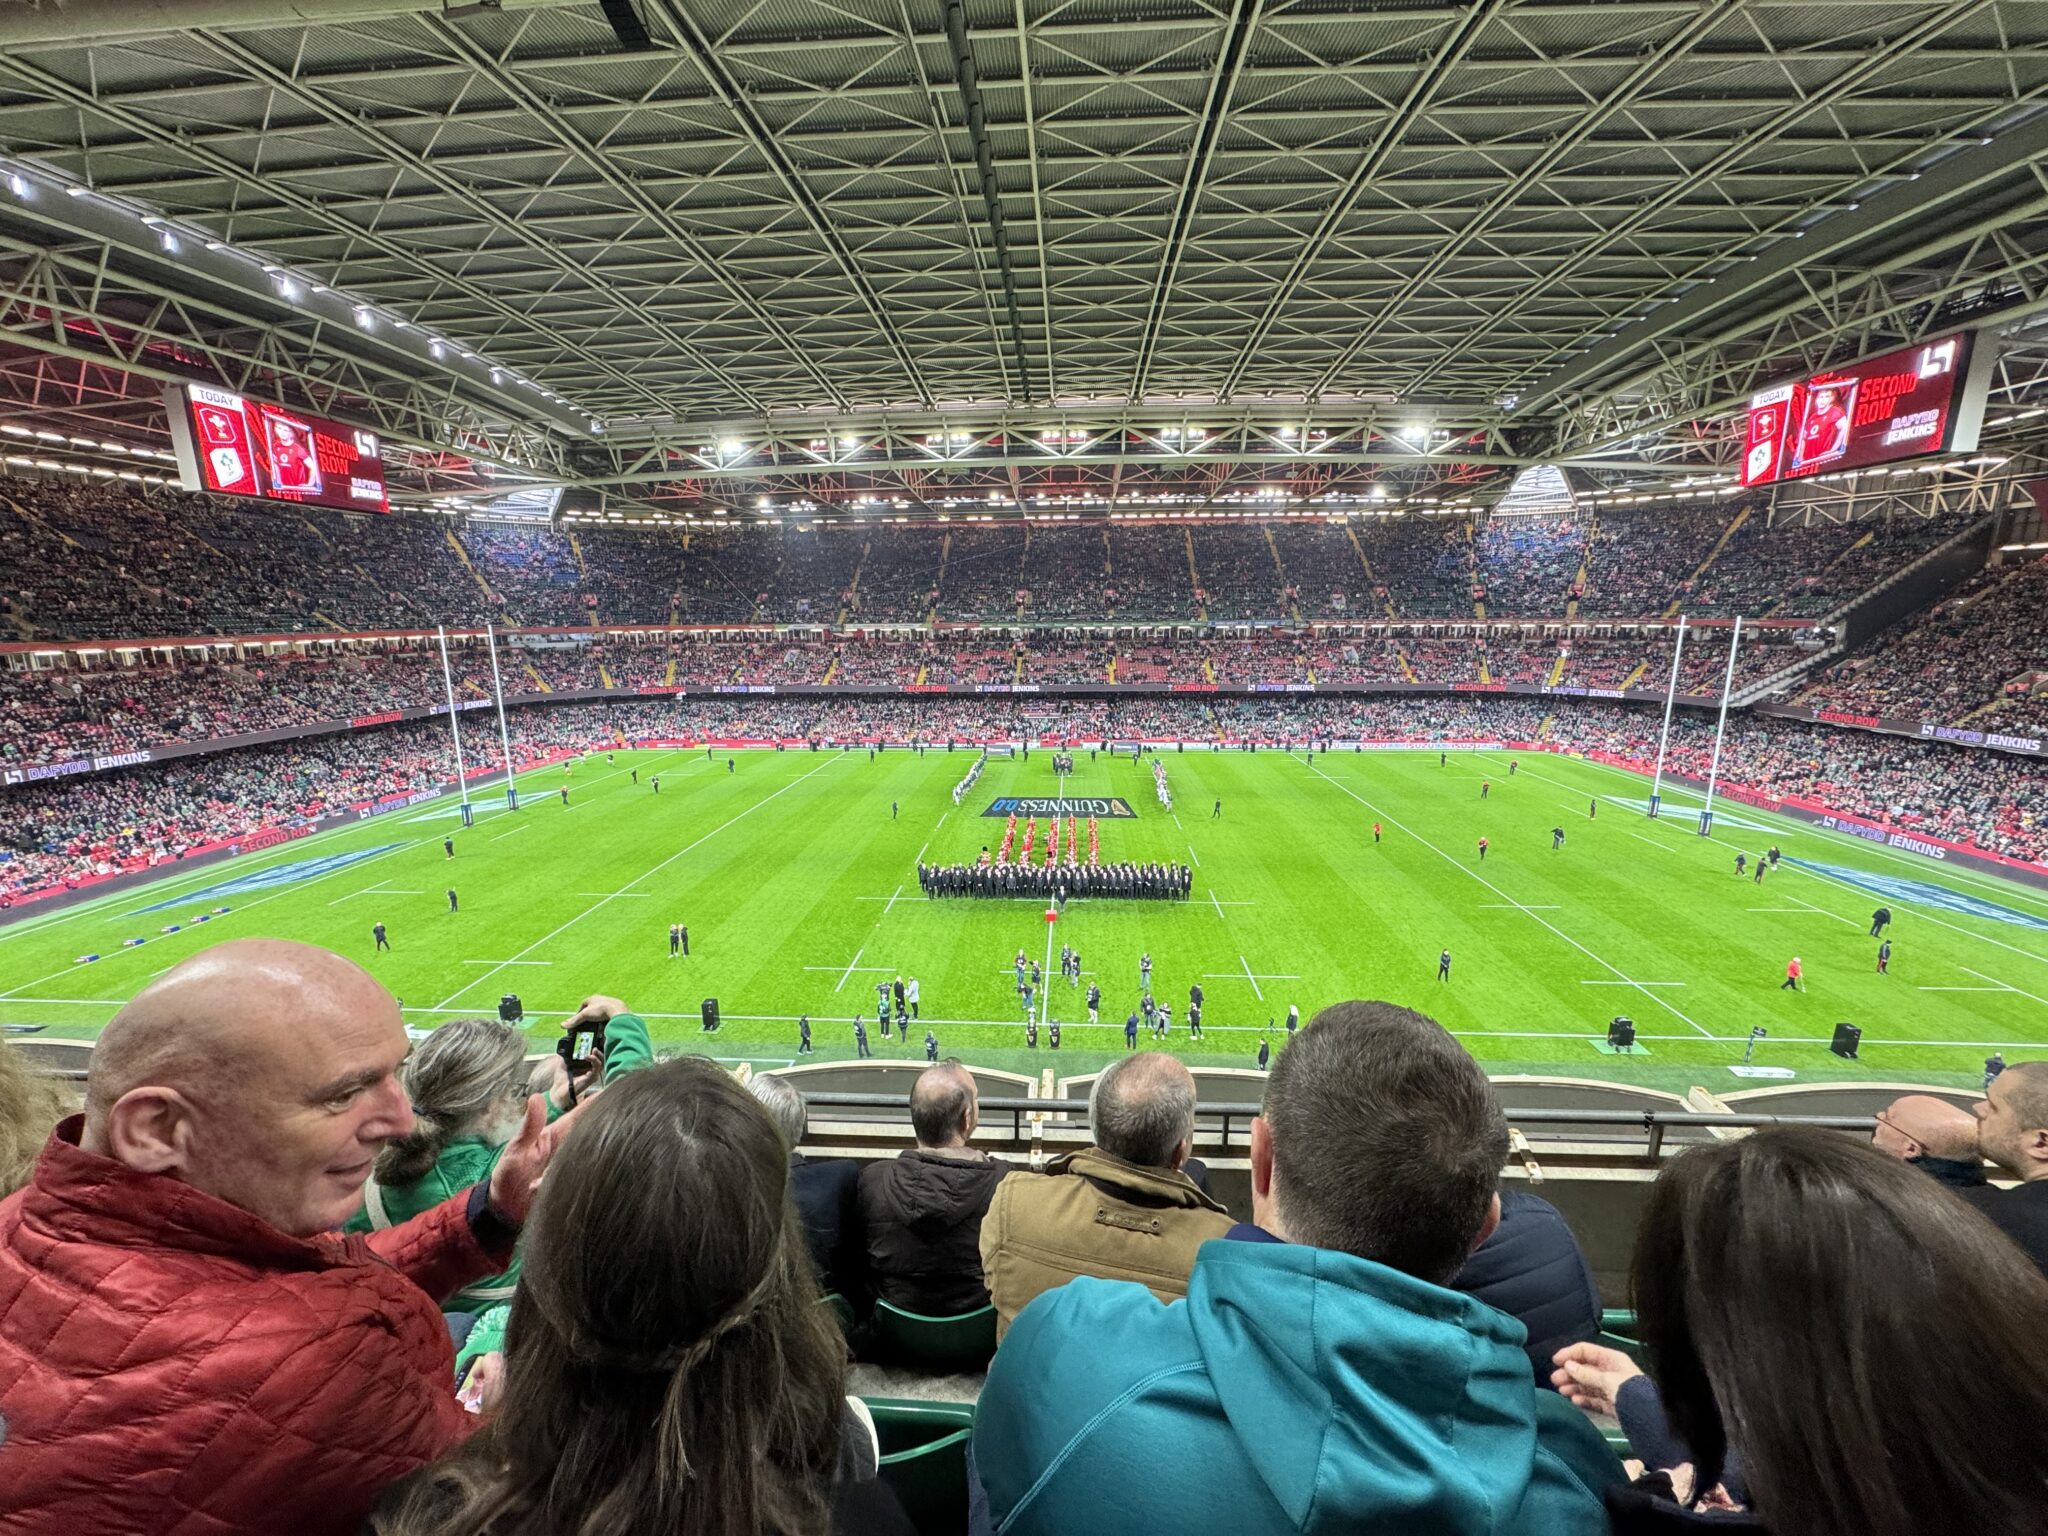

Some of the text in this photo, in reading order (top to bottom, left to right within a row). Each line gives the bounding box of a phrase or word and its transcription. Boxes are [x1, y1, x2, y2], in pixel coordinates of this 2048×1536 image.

[199, 389, 234, 407] TODAY
[1859, 373, 1919, 402] SECOND
[1855, 397, 1897, 426] ROW
[1888, 423, 1937, 445] JENKINS
[315, 432, 359, 461] SECOND
[319, 453, 350, 475] ROW
[1588, 688, 1625, 698] JENKINS
[352, 711, 403, 727] SECOND ROW
[1819, 711, 1880, 727] SECOND ROW
[1986, 733, 2041, 751] JENKINS
[28, 760, 90, 780] DAFYDD
[94, 750, 151, 770] JENKINS
[408, 787, 442, 806] JENKINS
[1018, 799, 1109, 815] GUINNESS
[1721, 786, 1782, 813] SECOND ROW
[239, 832, 289, 854] SECOND
[1837, 820, 1886, 842] DAFYDD
[1888, 833, 1946, 860] JENKINS
